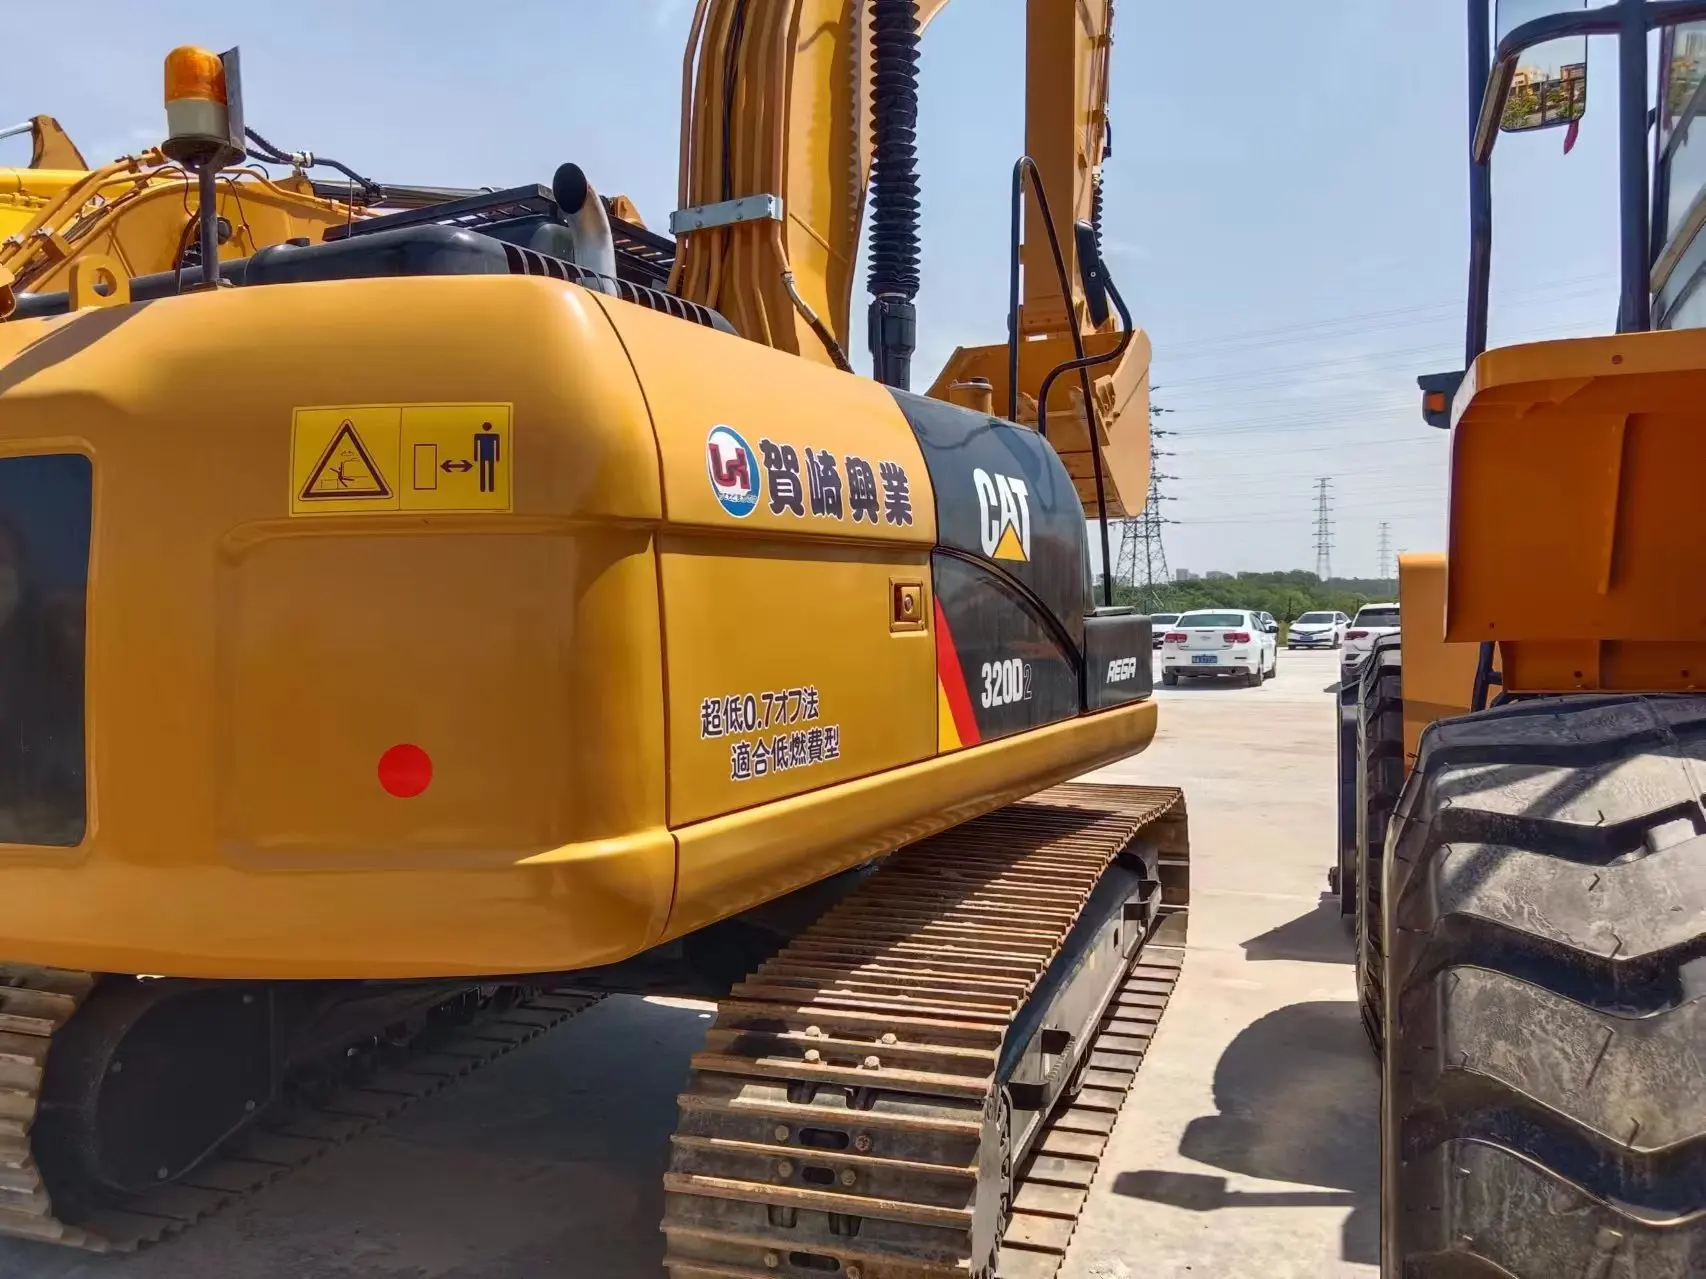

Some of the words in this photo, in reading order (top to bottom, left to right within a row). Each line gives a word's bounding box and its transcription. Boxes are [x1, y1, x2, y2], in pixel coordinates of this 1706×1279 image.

[973, 467, 1031, 562] CAT
[730, 724, 840, 781] 適合低燃費型
